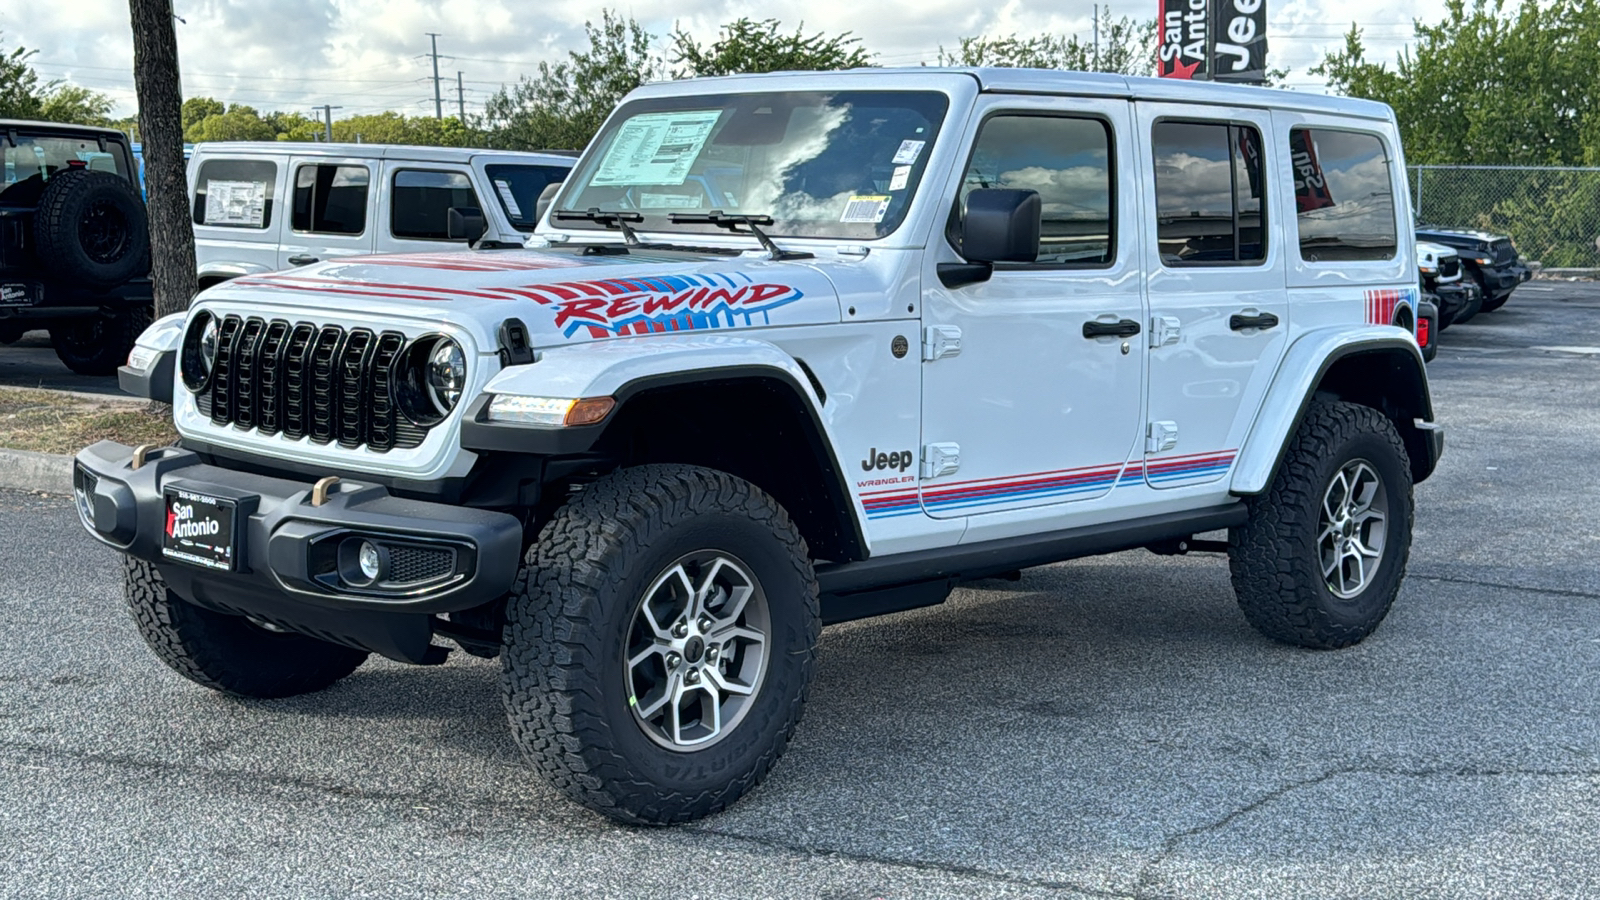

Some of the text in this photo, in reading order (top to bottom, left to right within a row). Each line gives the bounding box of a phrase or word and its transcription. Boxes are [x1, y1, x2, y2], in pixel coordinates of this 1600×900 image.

[1160, 11, 1182, 61] San
[554, 284, 792, 329] REWIND
[861, 447, 913, 472] Jeep
[857, 476, 915, 488] WRANGLER
[173, 502, 193, 520] San
[172, 516, 219, 538] Antonio
